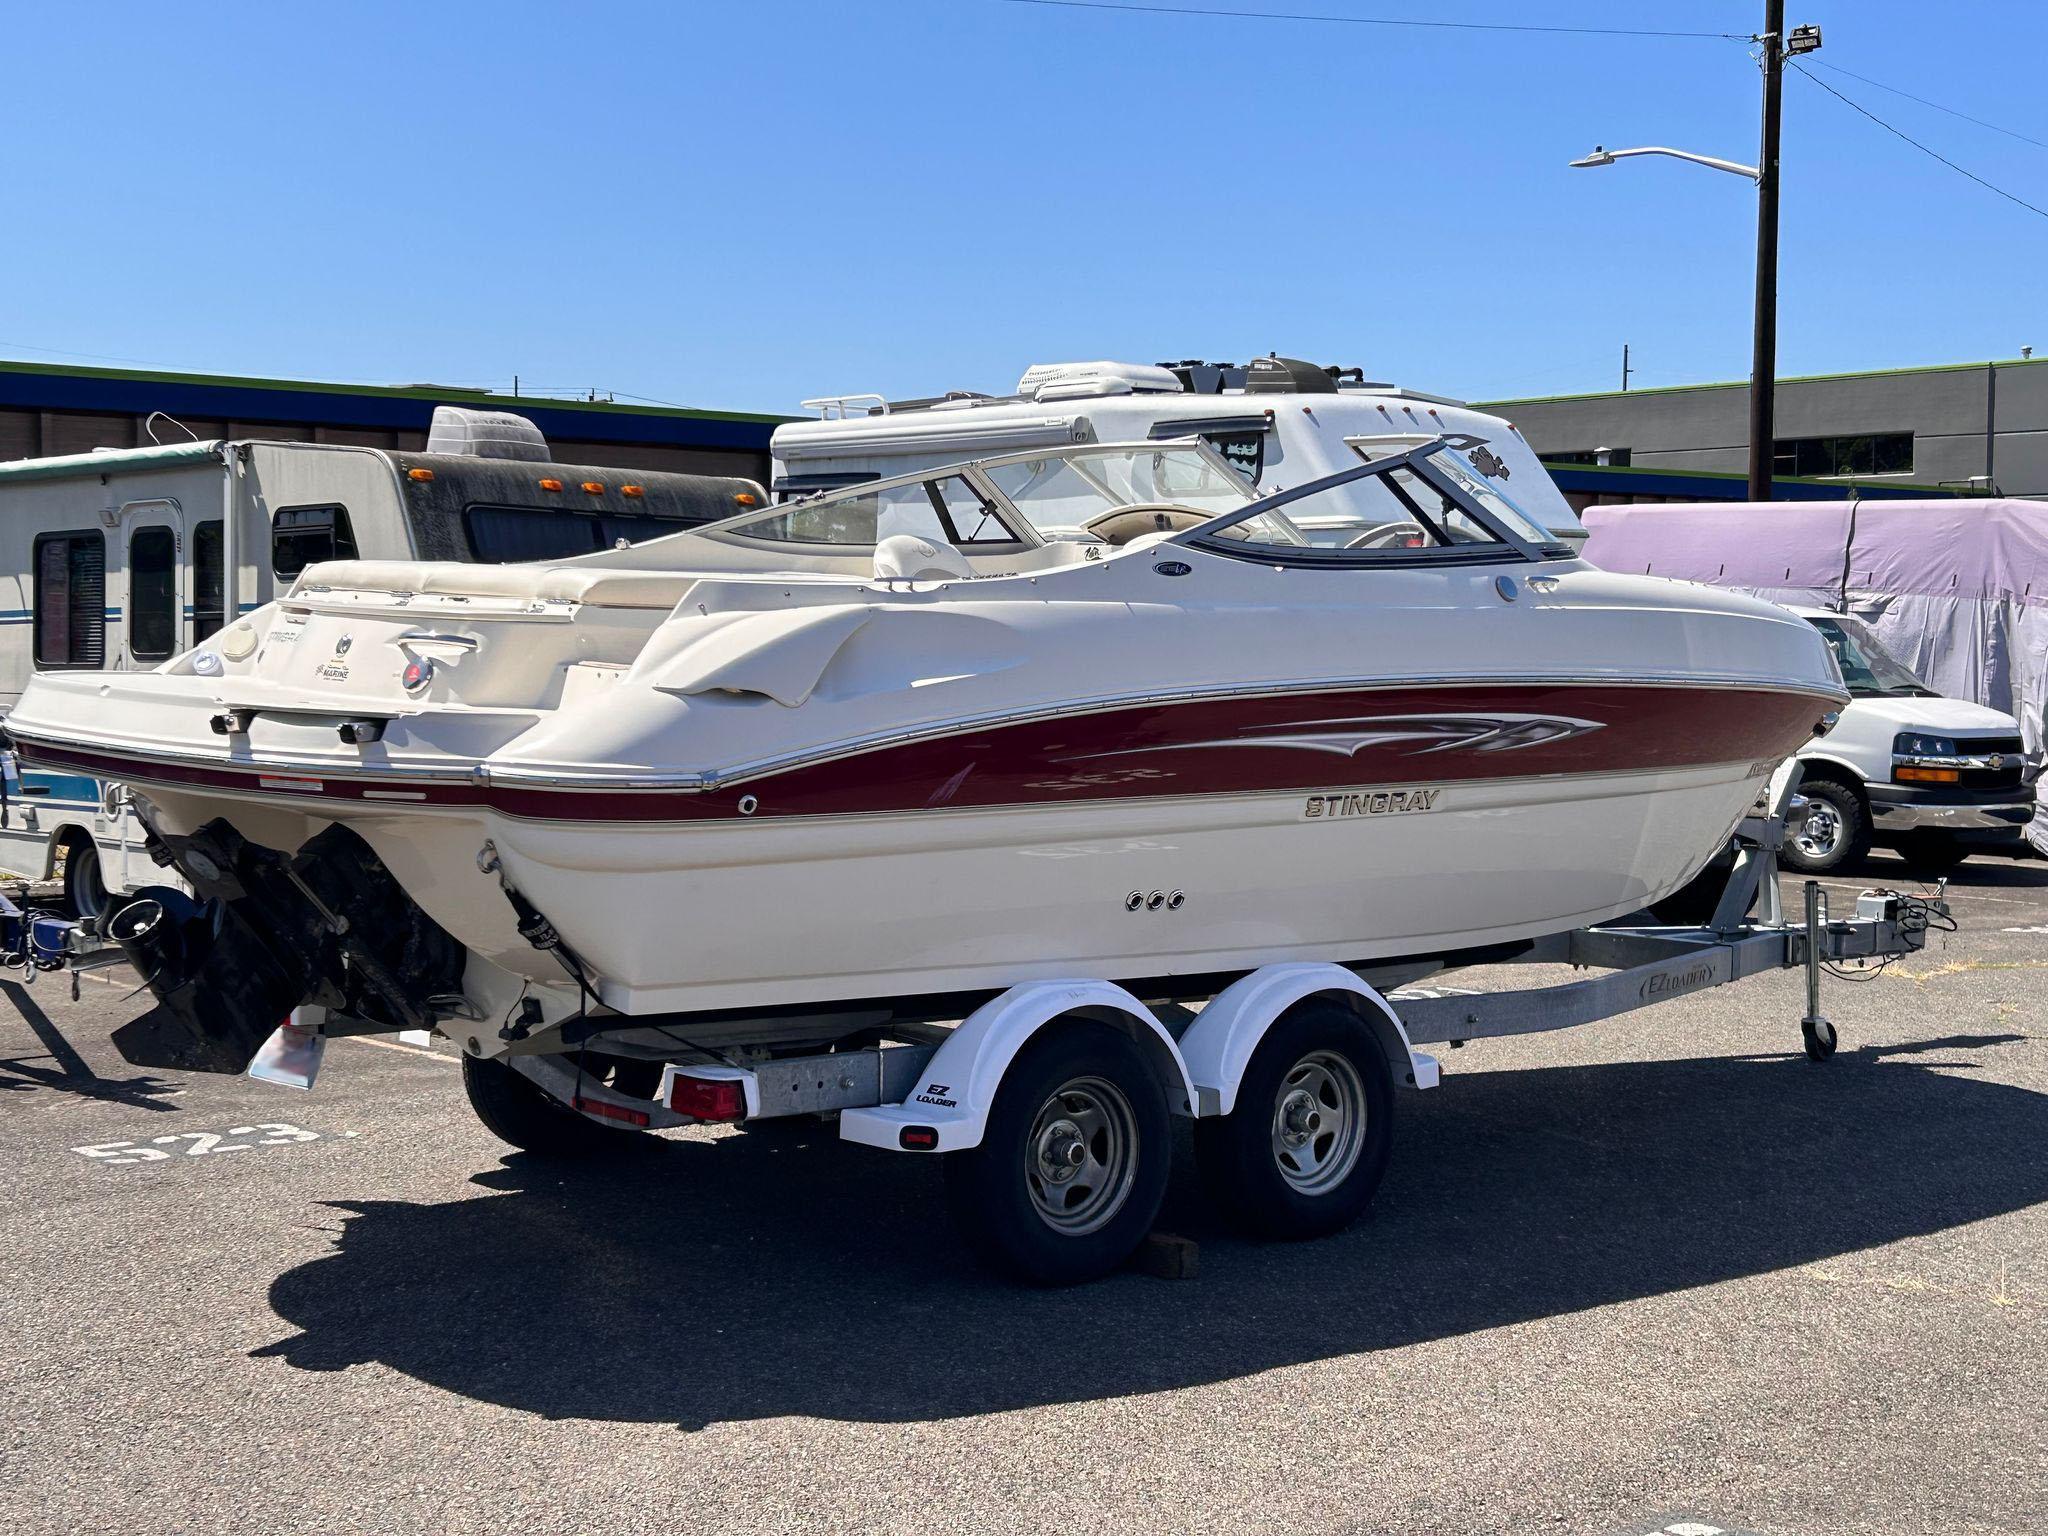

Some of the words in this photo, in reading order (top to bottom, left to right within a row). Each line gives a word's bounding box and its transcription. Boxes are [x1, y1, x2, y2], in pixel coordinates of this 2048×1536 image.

[1305, 789, 1441, 818] STINGRAY
[926, 1083, 950, 1096] EZ
[915, 1095, 957, 1108] LOADER
[70, 1122, 321, 1164] 523
